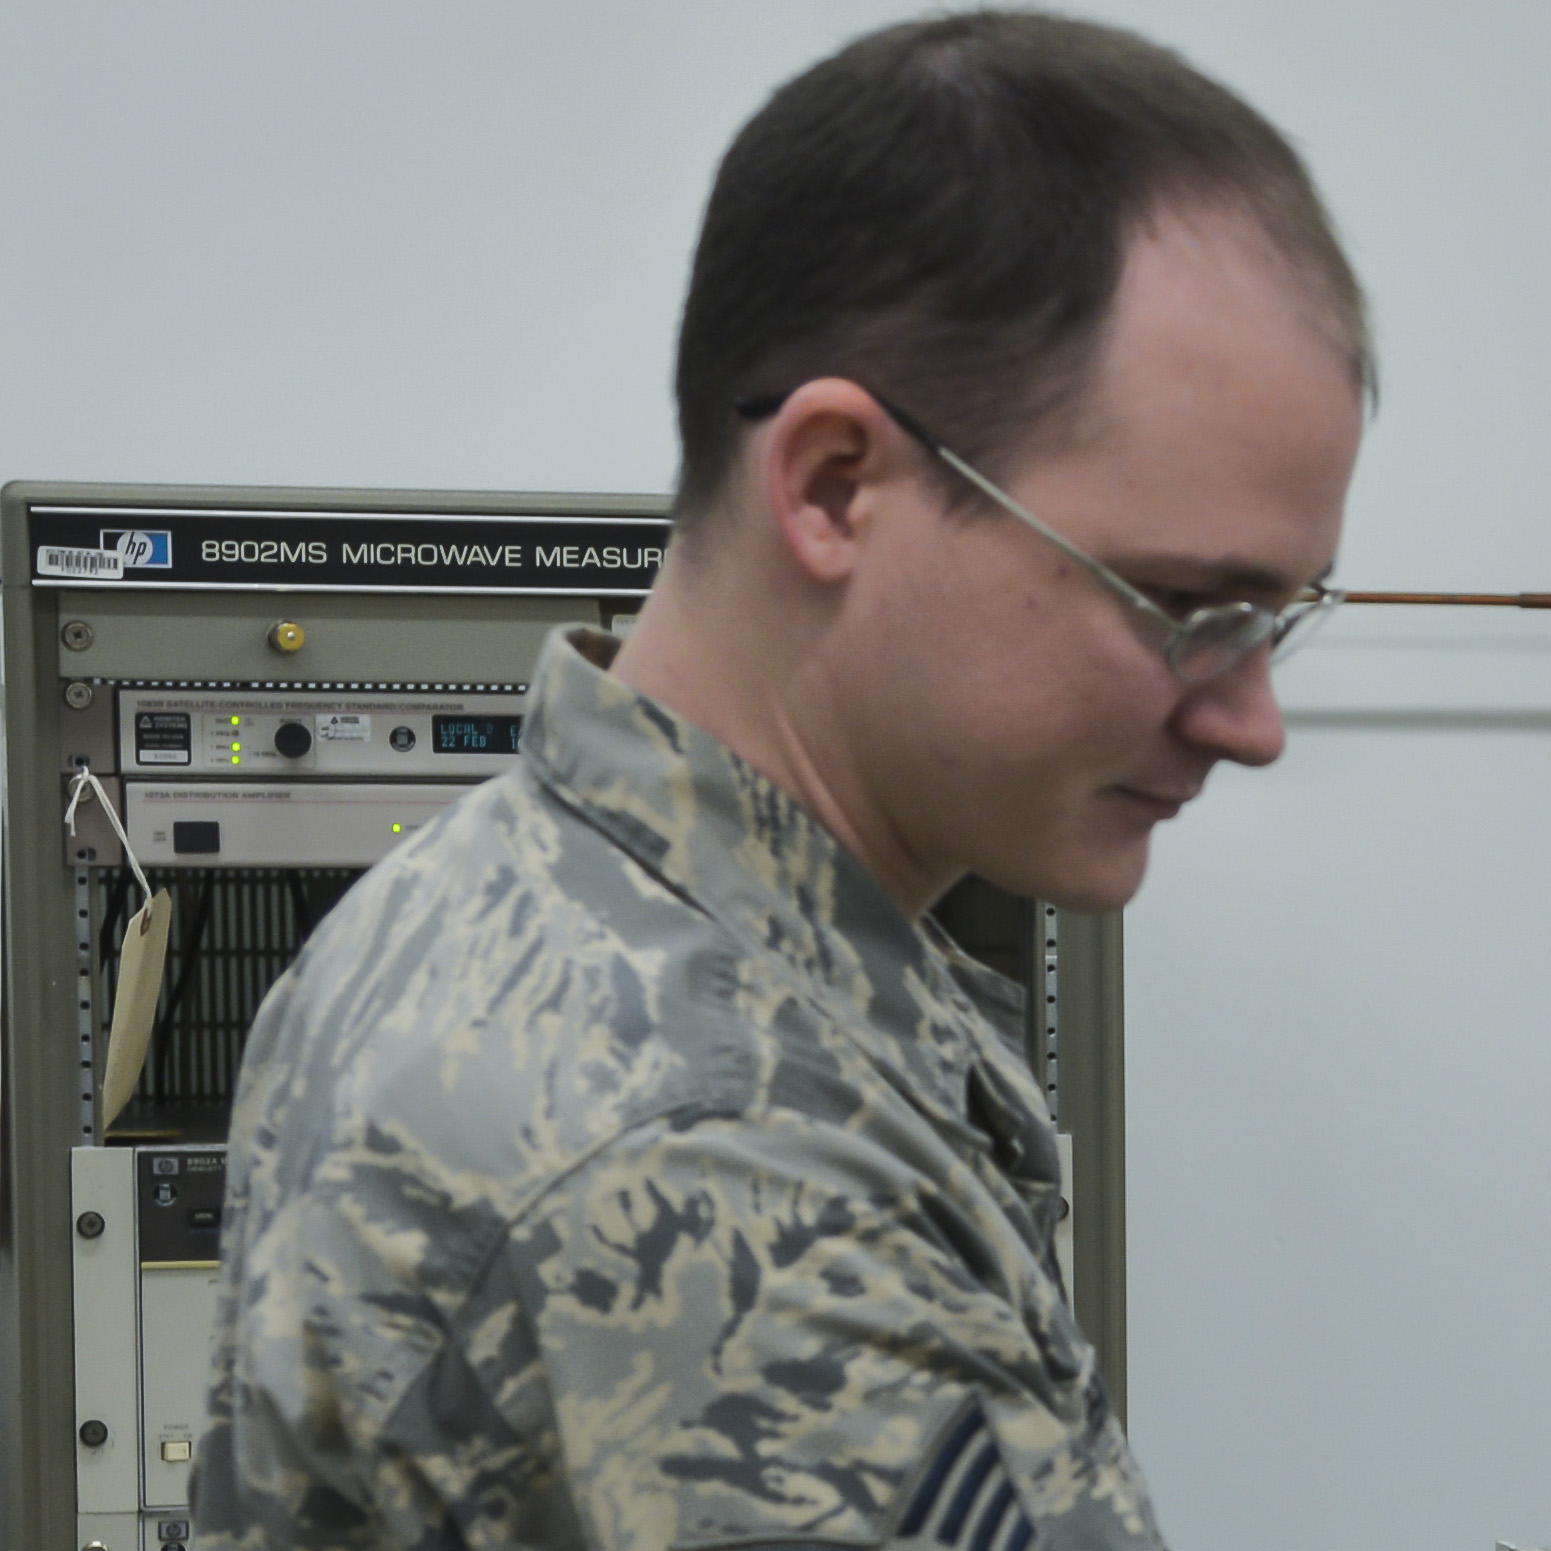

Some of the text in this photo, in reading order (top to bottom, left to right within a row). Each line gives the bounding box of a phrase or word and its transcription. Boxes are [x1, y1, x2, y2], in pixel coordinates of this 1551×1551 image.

[201, 540, 328, 564] 8902MS
[342, 543, 522, 567] MICROWAVE
[172, 791, 240, 799] DISTRIBUTION
[241, 791, 291, 799] AMPLIFIER
